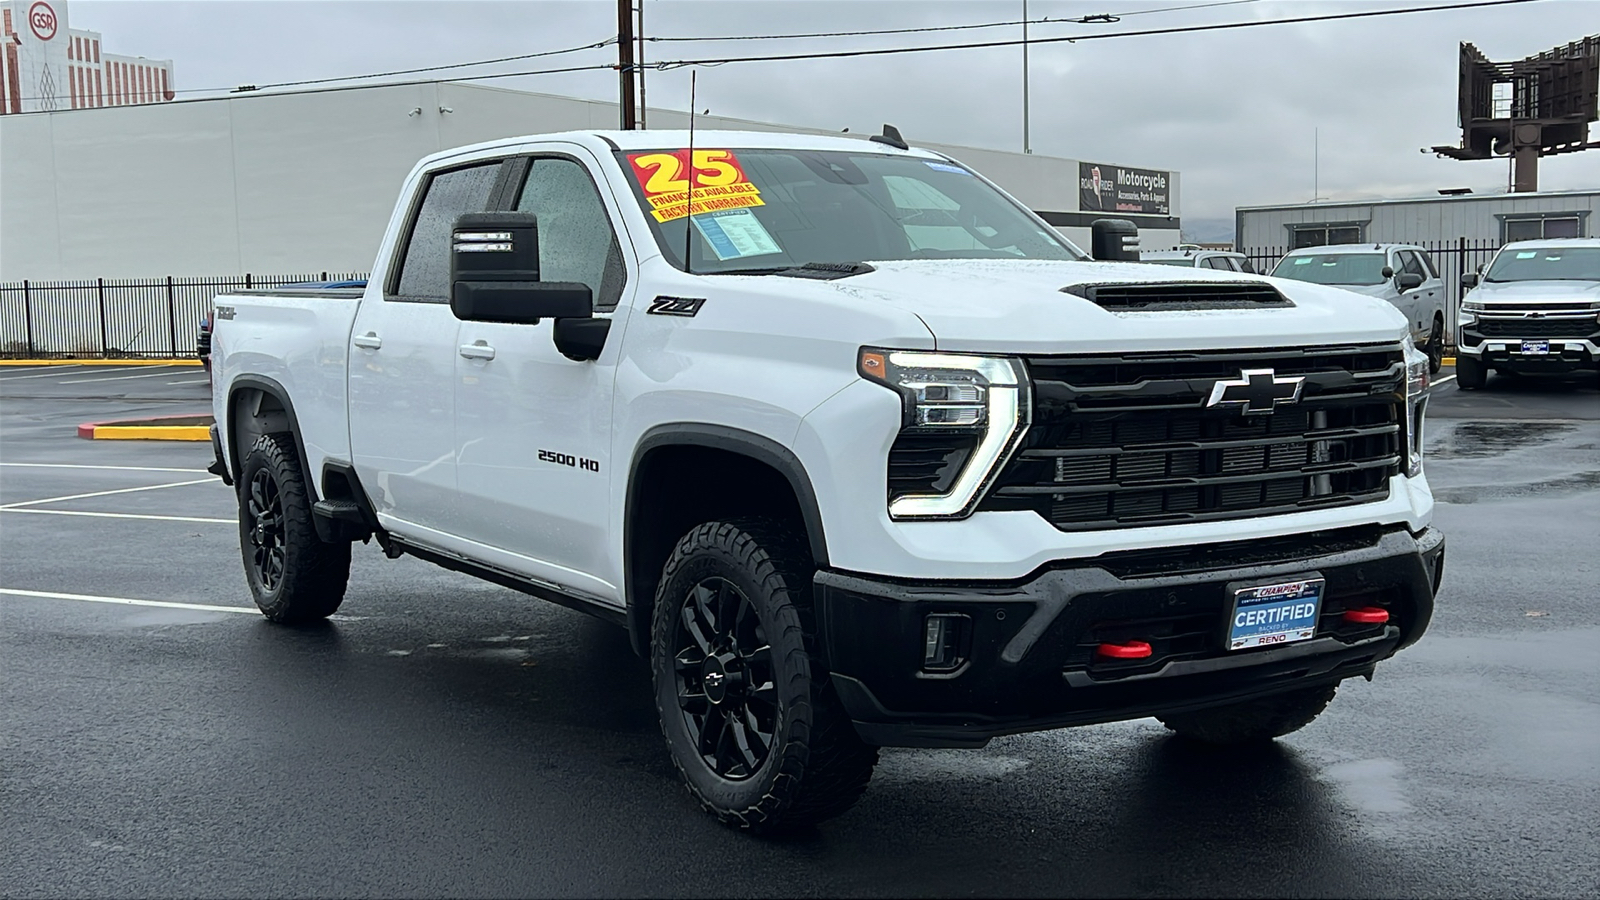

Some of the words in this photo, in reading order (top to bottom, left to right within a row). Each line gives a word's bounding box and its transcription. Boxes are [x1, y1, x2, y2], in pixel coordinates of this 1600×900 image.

[33, 12, 53, 30] GSR
[634, 150, 743, 194] 25
[1117, 169, 1166, 191] Motorcycle
[651, 189, 704, 207] FINANCING
[703, 184, 756, 197] AVAILABLE
[1100, 180, 1114, 191] RIDER
[658, 202, 705, 220] FACTORY
[705, 196, 758, 211] WARRANTY
[538, 449, 575, 467] 2500
[579, 457, 599, 473] HD
[1260, 583, 1303, 597] CHAMPION
[1235, 603, 1315, 628] CERTIFIED
[1258, 624, 1280, 632] BACKED
[1258, 634, 1287, 645] RENO
